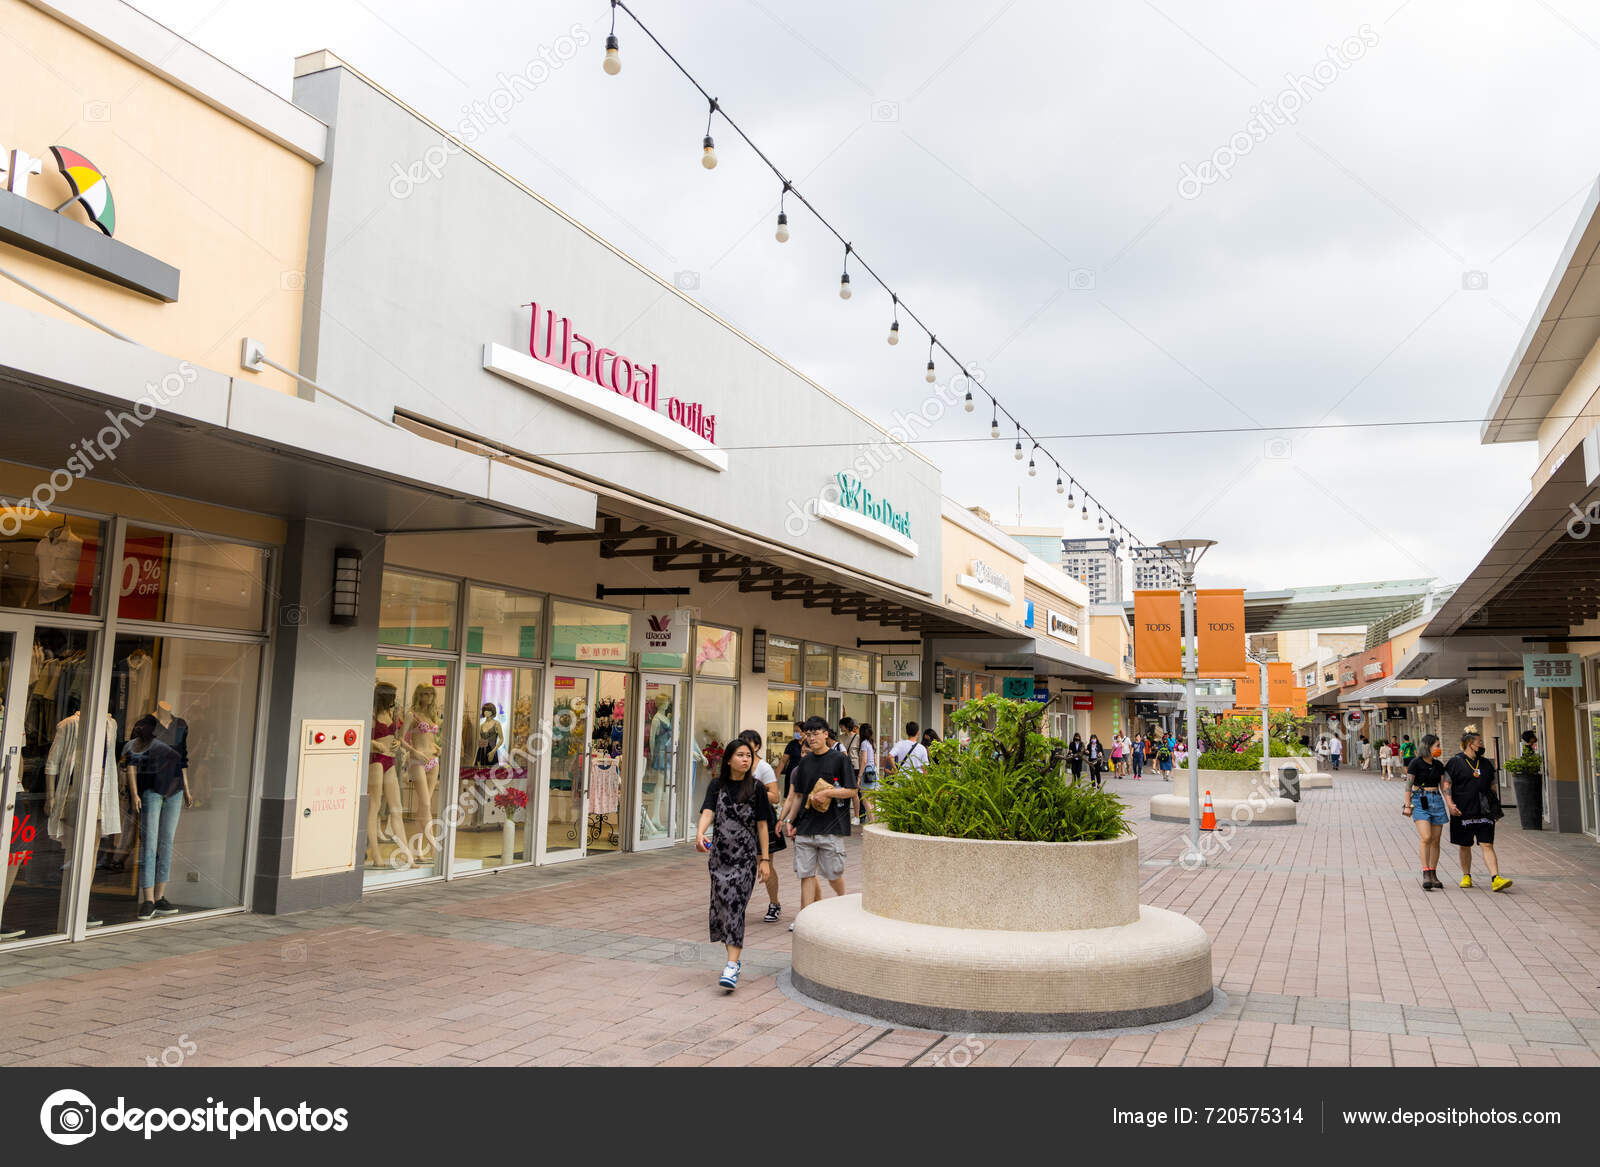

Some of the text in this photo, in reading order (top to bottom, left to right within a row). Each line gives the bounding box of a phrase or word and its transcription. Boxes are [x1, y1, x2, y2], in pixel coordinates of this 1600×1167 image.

[529, 302, 718, 446] Wacoal outlet
[138, 583, 160, 595] OFF
[1145, 623, 1171, 632] TOD'S
[1208, 622, 1235, 632] TOD'S
[645, 631, 672, 640] Wacoal
